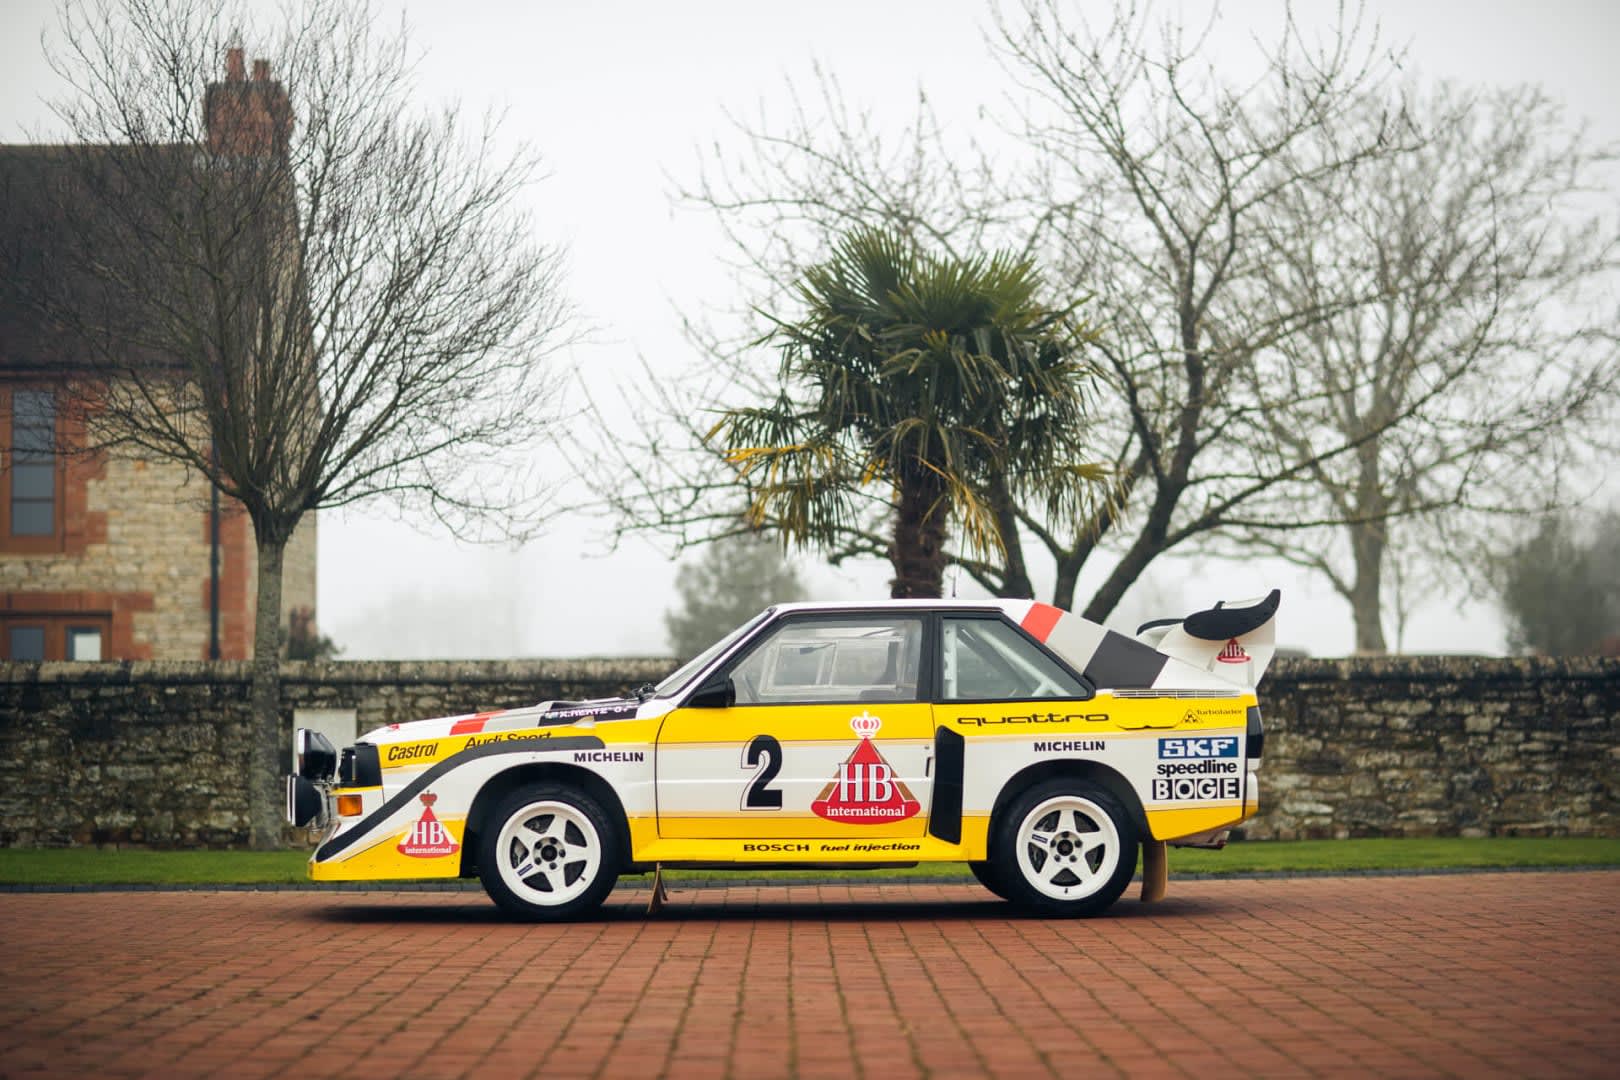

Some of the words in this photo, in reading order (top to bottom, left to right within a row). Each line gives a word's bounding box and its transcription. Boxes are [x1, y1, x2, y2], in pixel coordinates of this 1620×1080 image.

[957, 713, 1109, 727] quattro
[388, 742, 439, 761] Castrol
[1033, 741, 1105, 752] MICHELIN
[1162, 739, 1234, 757] SKF
[574, 752, 644, 763] MICHELIN
[740, 734, 783, 811] 2
[1157, 759, 1237, 778] speedline
[838, 762, 893, 802] HB
[1153, 778, 1240, 800] BOGE
[826, 804, 906, 817] international
[412, 821, 445, 845] HB
[743, 844, 810, 852] BOSCH
[820, 844, 850, 852] fuel
[853, 843, 921, 852] injection
